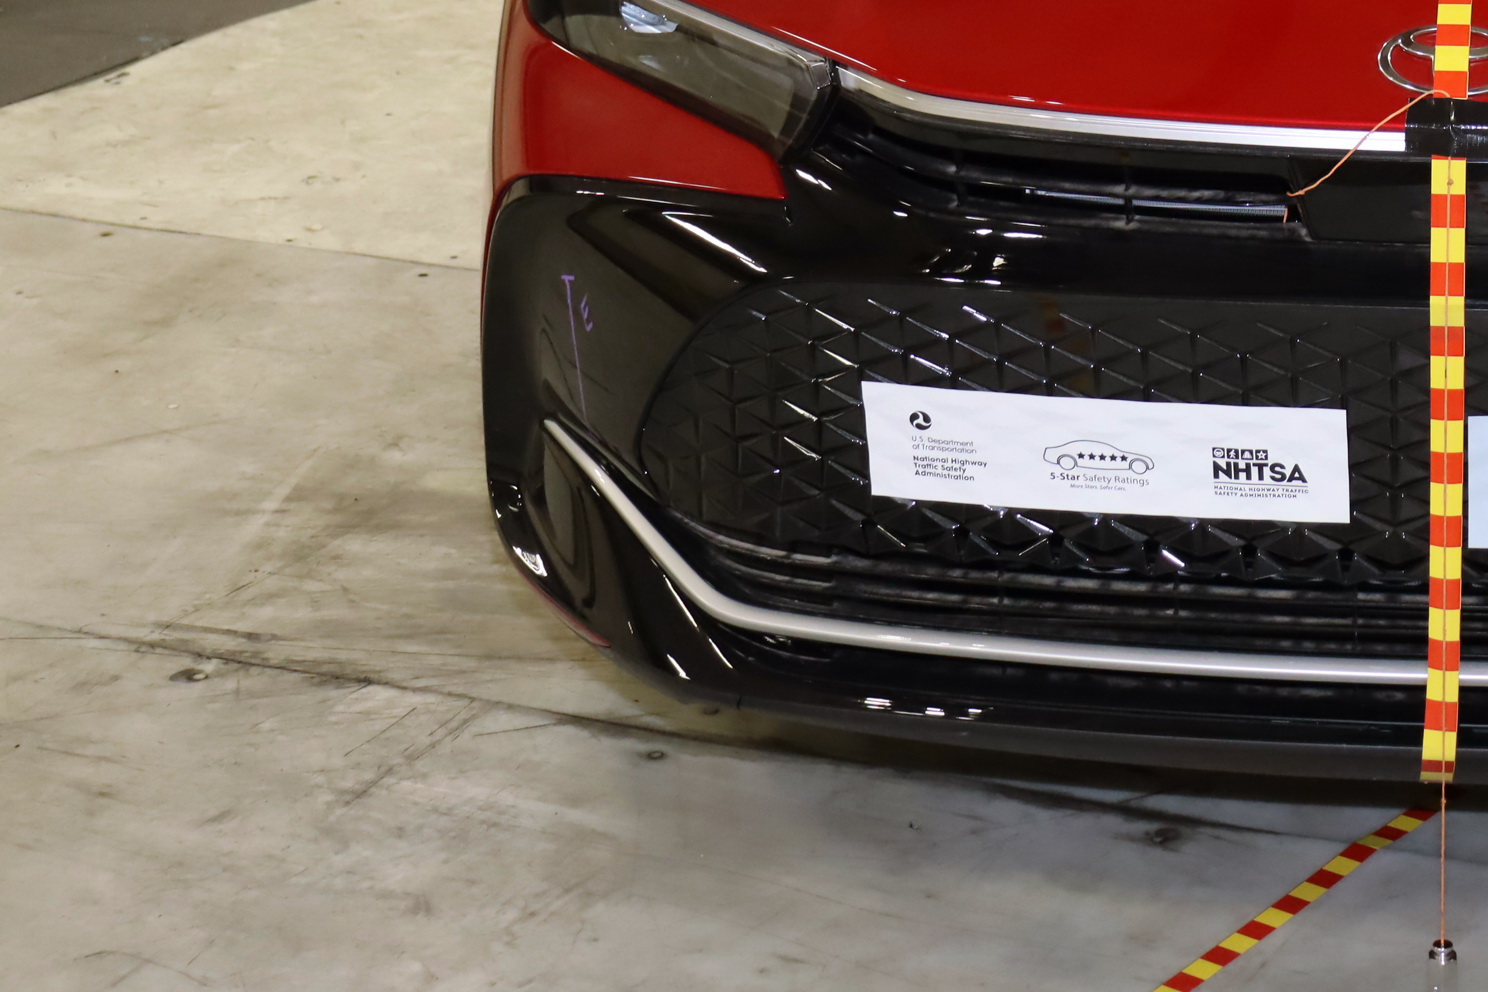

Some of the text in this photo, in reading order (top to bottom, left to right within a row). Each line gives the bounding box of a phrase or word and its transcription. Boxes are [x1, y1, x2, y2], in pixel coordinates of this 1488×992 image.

[911, 435, 974, 448] U.S. Department
[922, 443, 977, 454] Transportation
[912, 455, 988, 468] National Highway
[913, 462, 967, 474] Traffic Safety
[914, 469, 975, 482] Administration
[1212, 460, 1308, 484] NHTSA
[1050, 472, 1150, 487] 5-Star Safety Ratings
